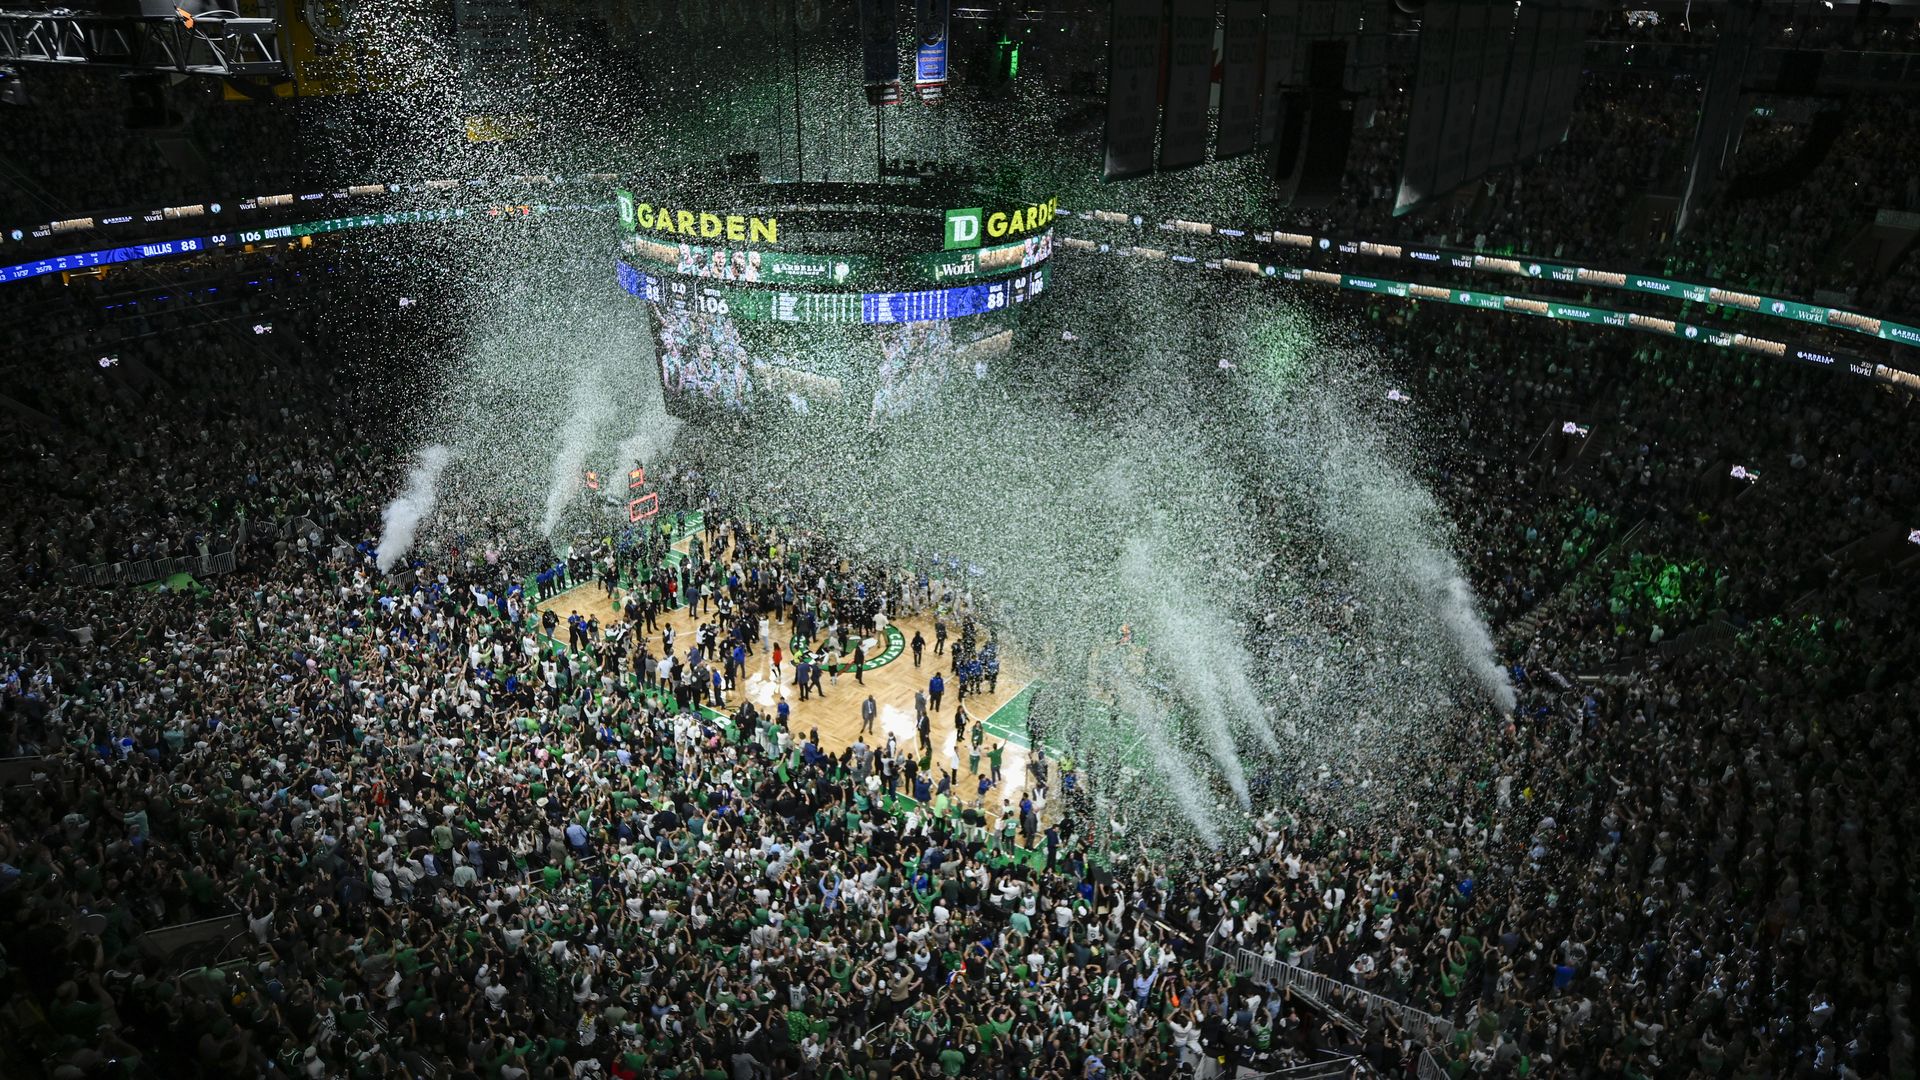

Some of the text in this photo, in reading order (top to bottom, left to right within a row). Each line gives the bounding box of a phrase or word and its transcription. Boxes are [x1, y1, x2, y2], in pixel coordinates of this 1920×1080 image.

[240, 203, 256, 211] World
[637, 203, 778, 244] GARDEN
[948, 215, 979, 242] TD
[987, 196, 1056, 238] GARDE
[32, 229, 51, 238] World
[212, 234, 226, 243] 0.0
[240, 226, 291, 243] 106 BOSTON
[143, 240, 197, 257] DALLAS 88
[1339, 244, 1358, 253] World
[942, 261, 975, 276] World
[1452, 258, 1472, 268] World
[13, 270, 28, 278] 11/37
[1552, 271, 1574, 281] World
[672, 282, 686, 295] 0.0
[1015, 277, 1026, 289] 0.0
[988, 292, 1004, 309] 88
[1683, 290, 1706, 301] World
[699, 296, 729, 314] 106
[1480, 299, 1501, 309] World
[1603, 316, 1625, 326] World
[1799, 309, 1881, 334] World CHAMPIONS
[1709, 334, 1787, 357] World CHAMPIONS
[1850, 364, 1872, 376] World
[866, 633, 903, 669] CELTICS
